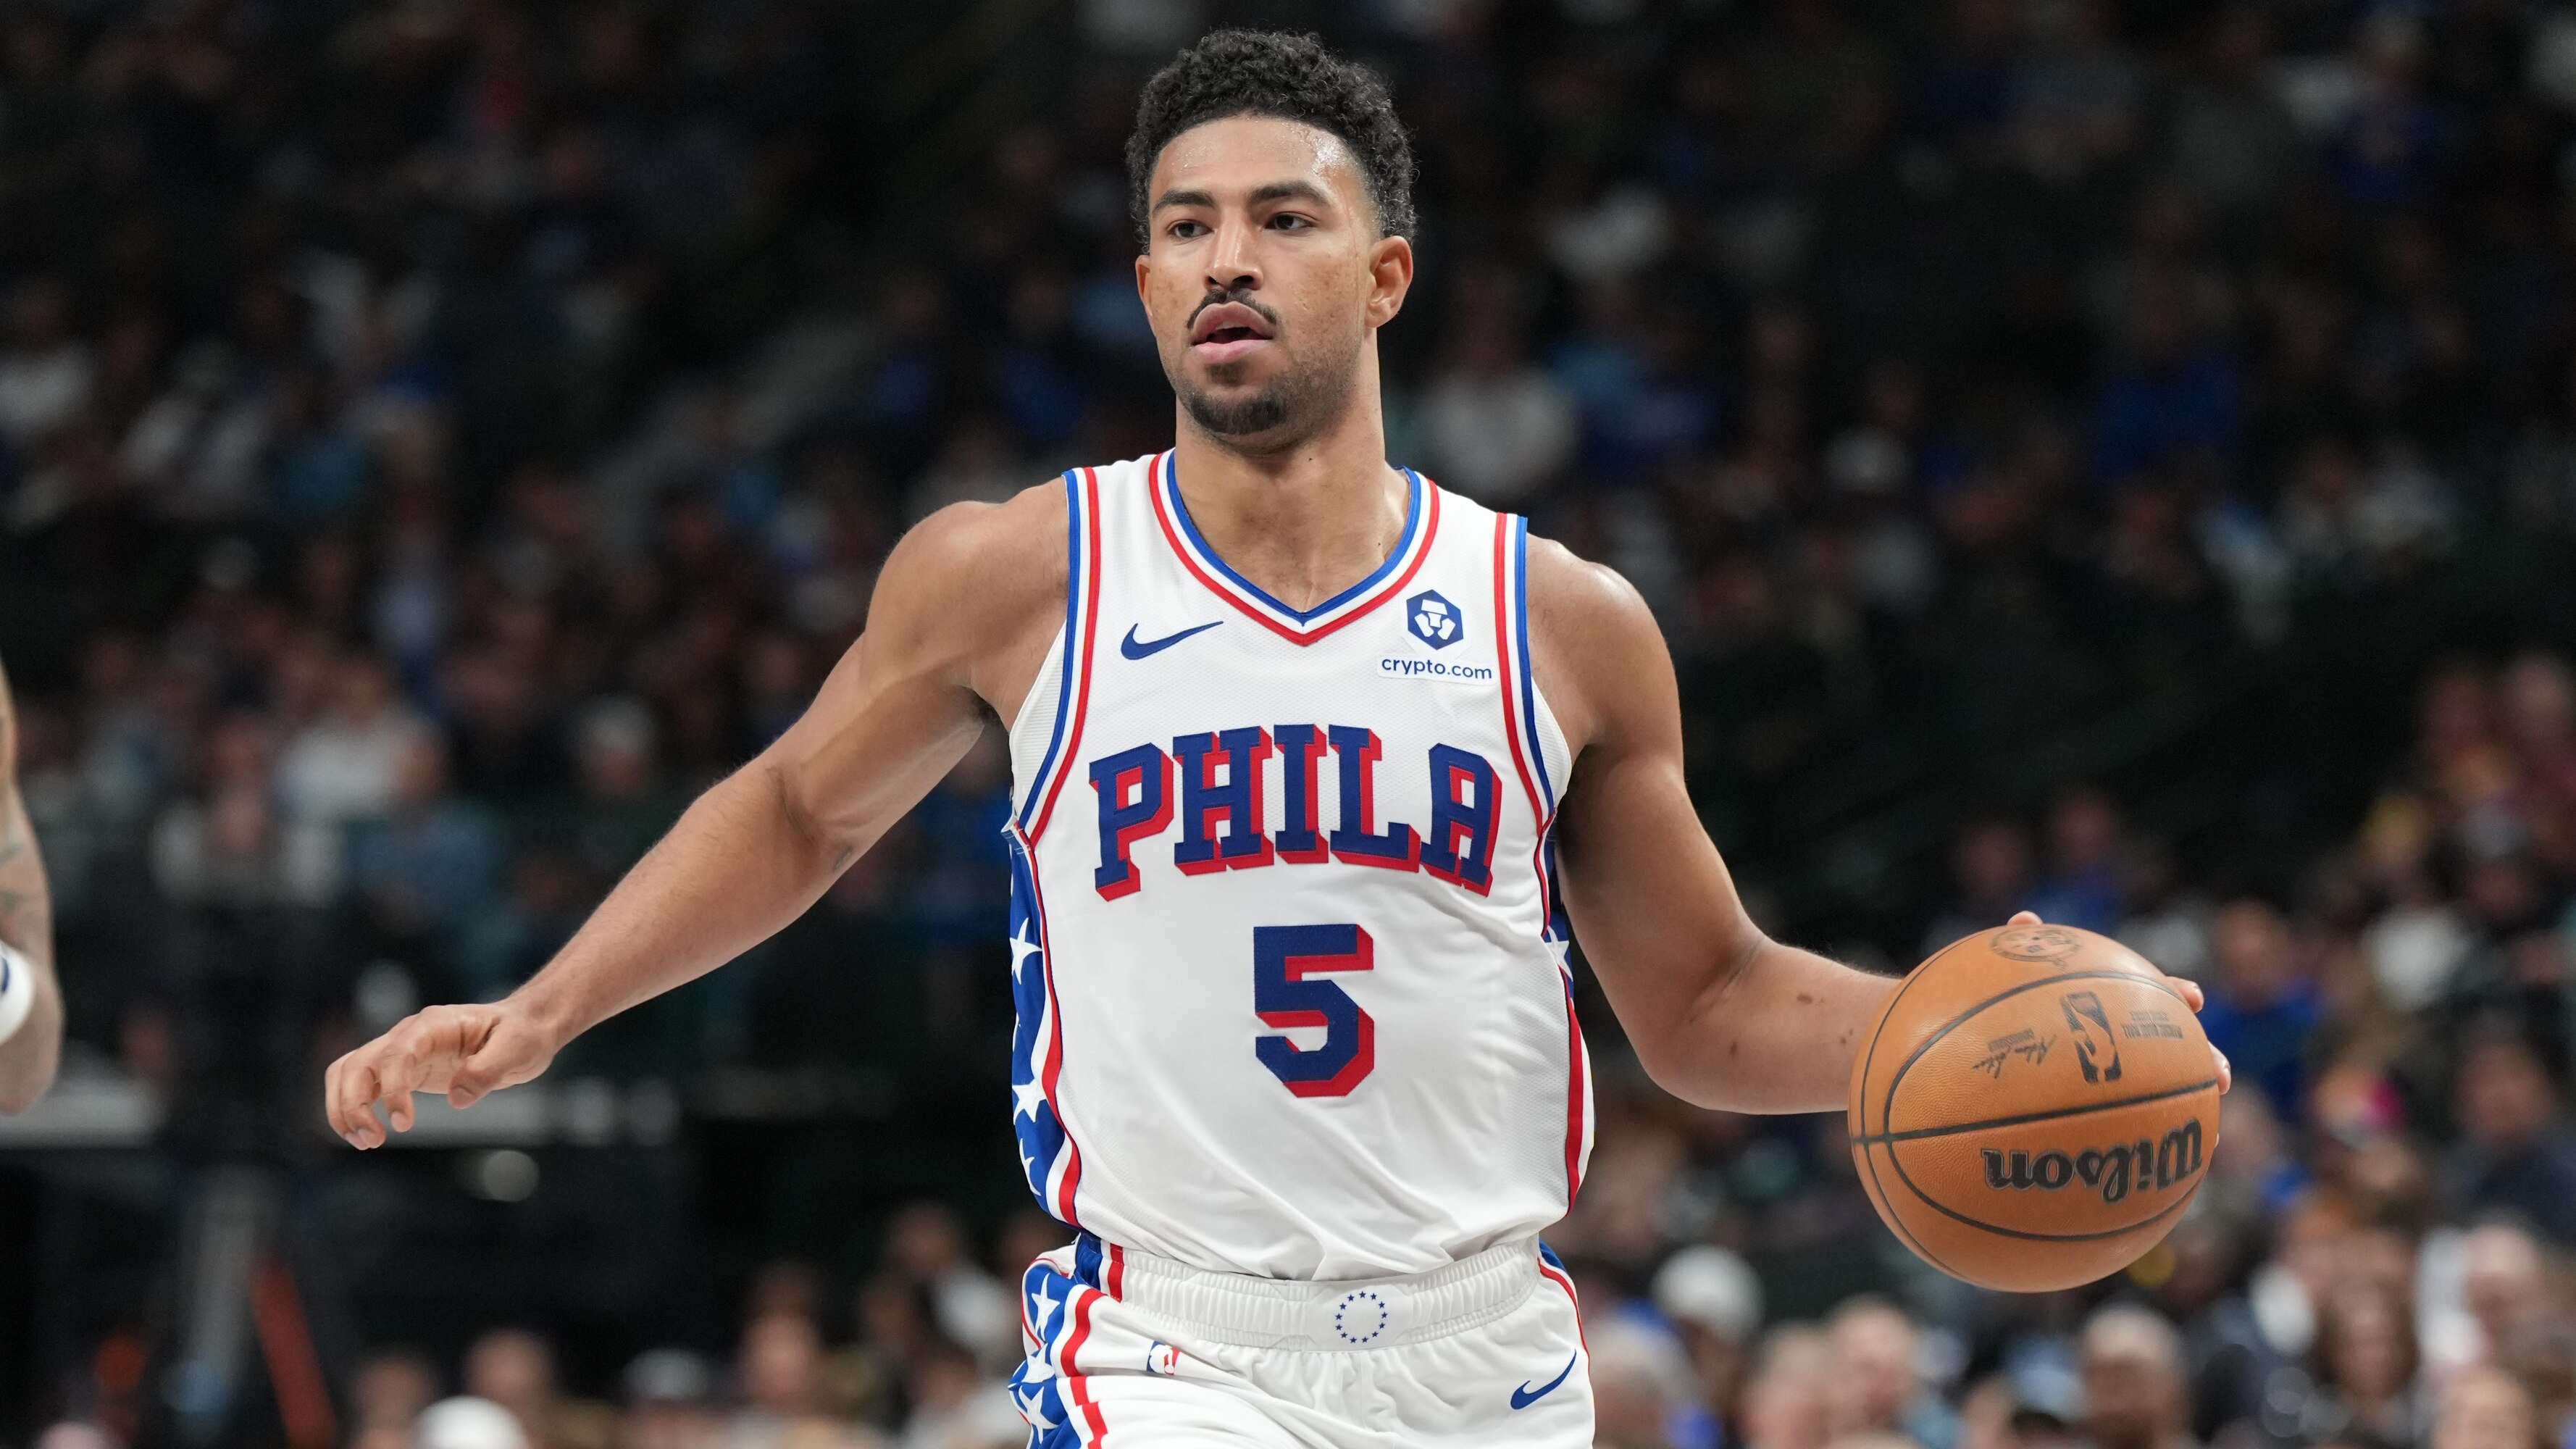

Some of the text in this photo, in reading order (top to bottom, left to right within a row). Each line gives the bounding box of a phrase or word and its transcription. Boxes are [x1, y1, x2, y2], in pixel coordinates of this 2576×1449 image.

[1381, 659, 1492, 680] crypto.com
[1089, 724, 1502, 902] PHILA
[1253, 924, 1375, 1098] 5
[1981, 1118, 2203, 1203] Wilson
